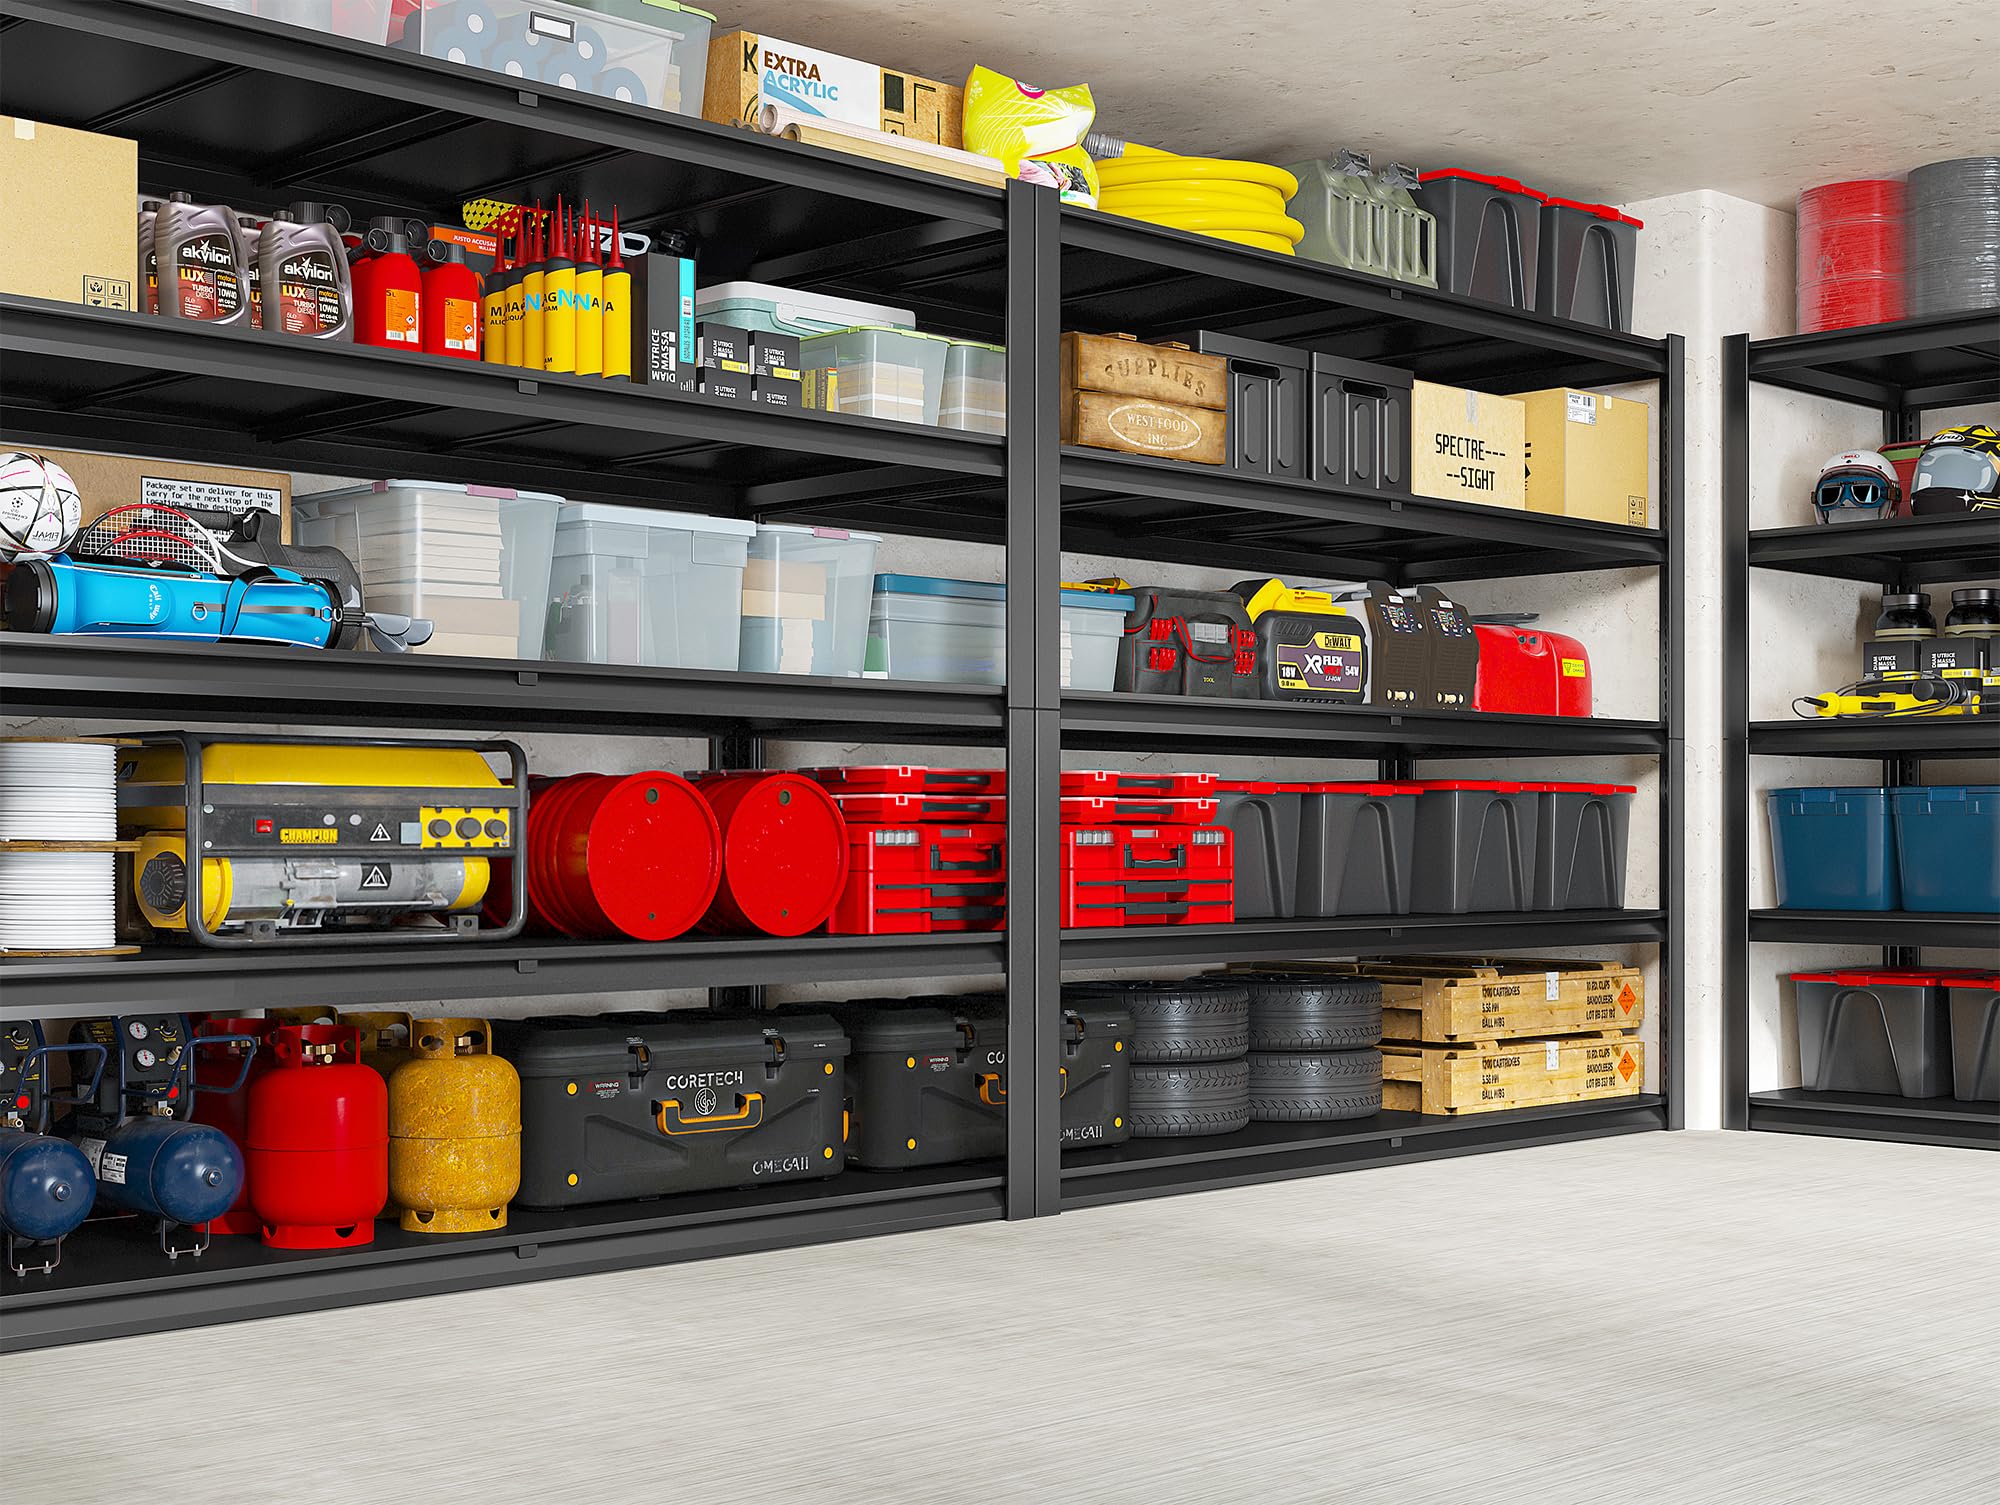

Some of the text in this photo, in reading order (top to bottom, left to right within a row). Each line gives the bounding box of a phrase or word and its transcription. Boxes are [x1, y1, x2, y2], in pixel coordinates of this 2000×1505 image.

[764, 50, 822, 82] EXTRA
[764, 69, 839, 101] ACRYLIC
[180, 268, 205, 283] LUX
[192, 284, 214, 294] TURBO
[282, 285, 306, 299] LUX
[293, 300, 315, 309] TURBO
[651, 328, 660, 369] UTRICE
[660, 331, 669, 370] MASSA
[717, 341, 734, 349] UTRICE
[769, 348, 785, 357] UTRICE
[651, 370, 676, 383] DIAM
[1104, 358, 1206, 397] SUPPLIES
[720, 387, 736, 395] UTRICE
[771, 394, 788, 402] UTRICE
[1127, 413, 1189, 432] WEST FOOD
[146, 481, 176, 492] Package
[179, 484, 192, 492] set
[208, 487, 237, 497] deliver
[241, 490, 252, 498] for
[257, 491, 273, 500] this
[146, 491, 167, 500] carry
[188, 493, 201, 501] the
[224, 497, 241, 506] stop
[261, 500, 273, 508] the
[196, 501, 209, 509] the
[1303, 654, 1343, 674] XR FLEX
[1281, 666, 1296, 678] 18V
[1345, 665, 1359, 677] 54V
[281, 829, 337, 841] CHAMPION
[1599, 980, 1611, 990] CLIPS
[1493, 986, 1520, 998] CARTRIDGES
[1586, 995, 1613, 1005] BANDOLEERS
[1586, 1010, 1594, 1020] LOT
[1482, 1018, 1493, 1028] BALL
[1599, 1047, 1611, 1057] CLIPS
[1493, 1057, 1520, 1069] CARTRIDGES
[1586, 1062, 1613, 1072] BANDOLEERS
[666, 1071, 743, 1090] CORETECH
[1586, 1077, 1594, 1087] LOT
[1482, 1089, 1493, 1099] BALL
